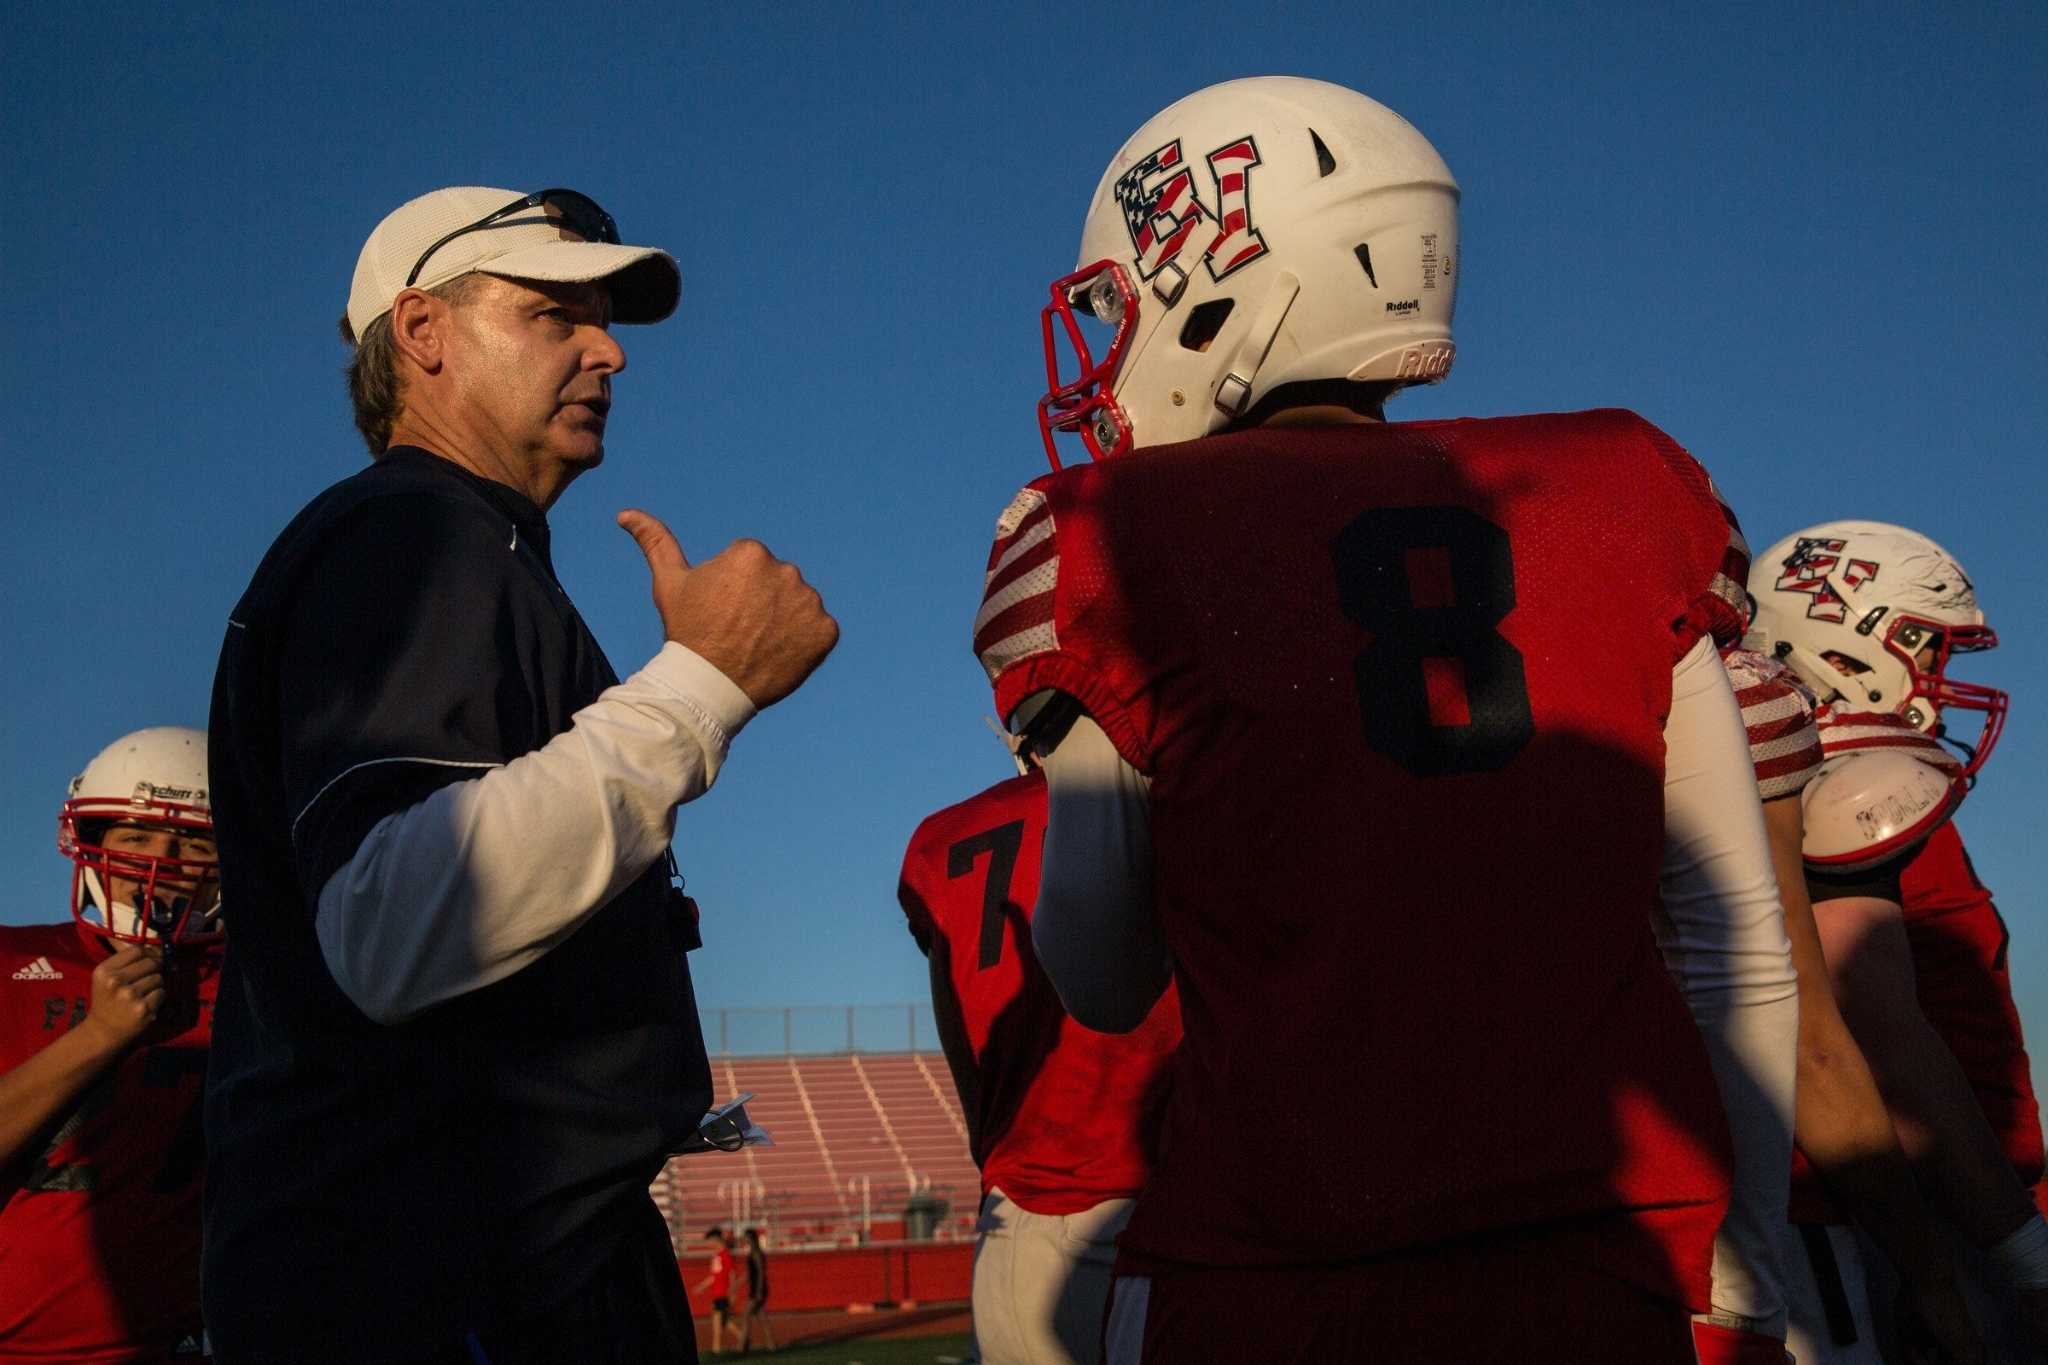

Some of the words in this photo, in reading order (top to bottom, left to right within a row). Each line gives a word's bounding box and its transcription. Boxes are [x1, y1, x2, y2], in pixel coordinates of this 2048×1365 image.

[1386, 299, 1420, 312] Riddell
[1395, 346, 1456, 378] Ridd
[1328, 505, 1537, 777] 8
[12, 971, 64, 981] adidas
